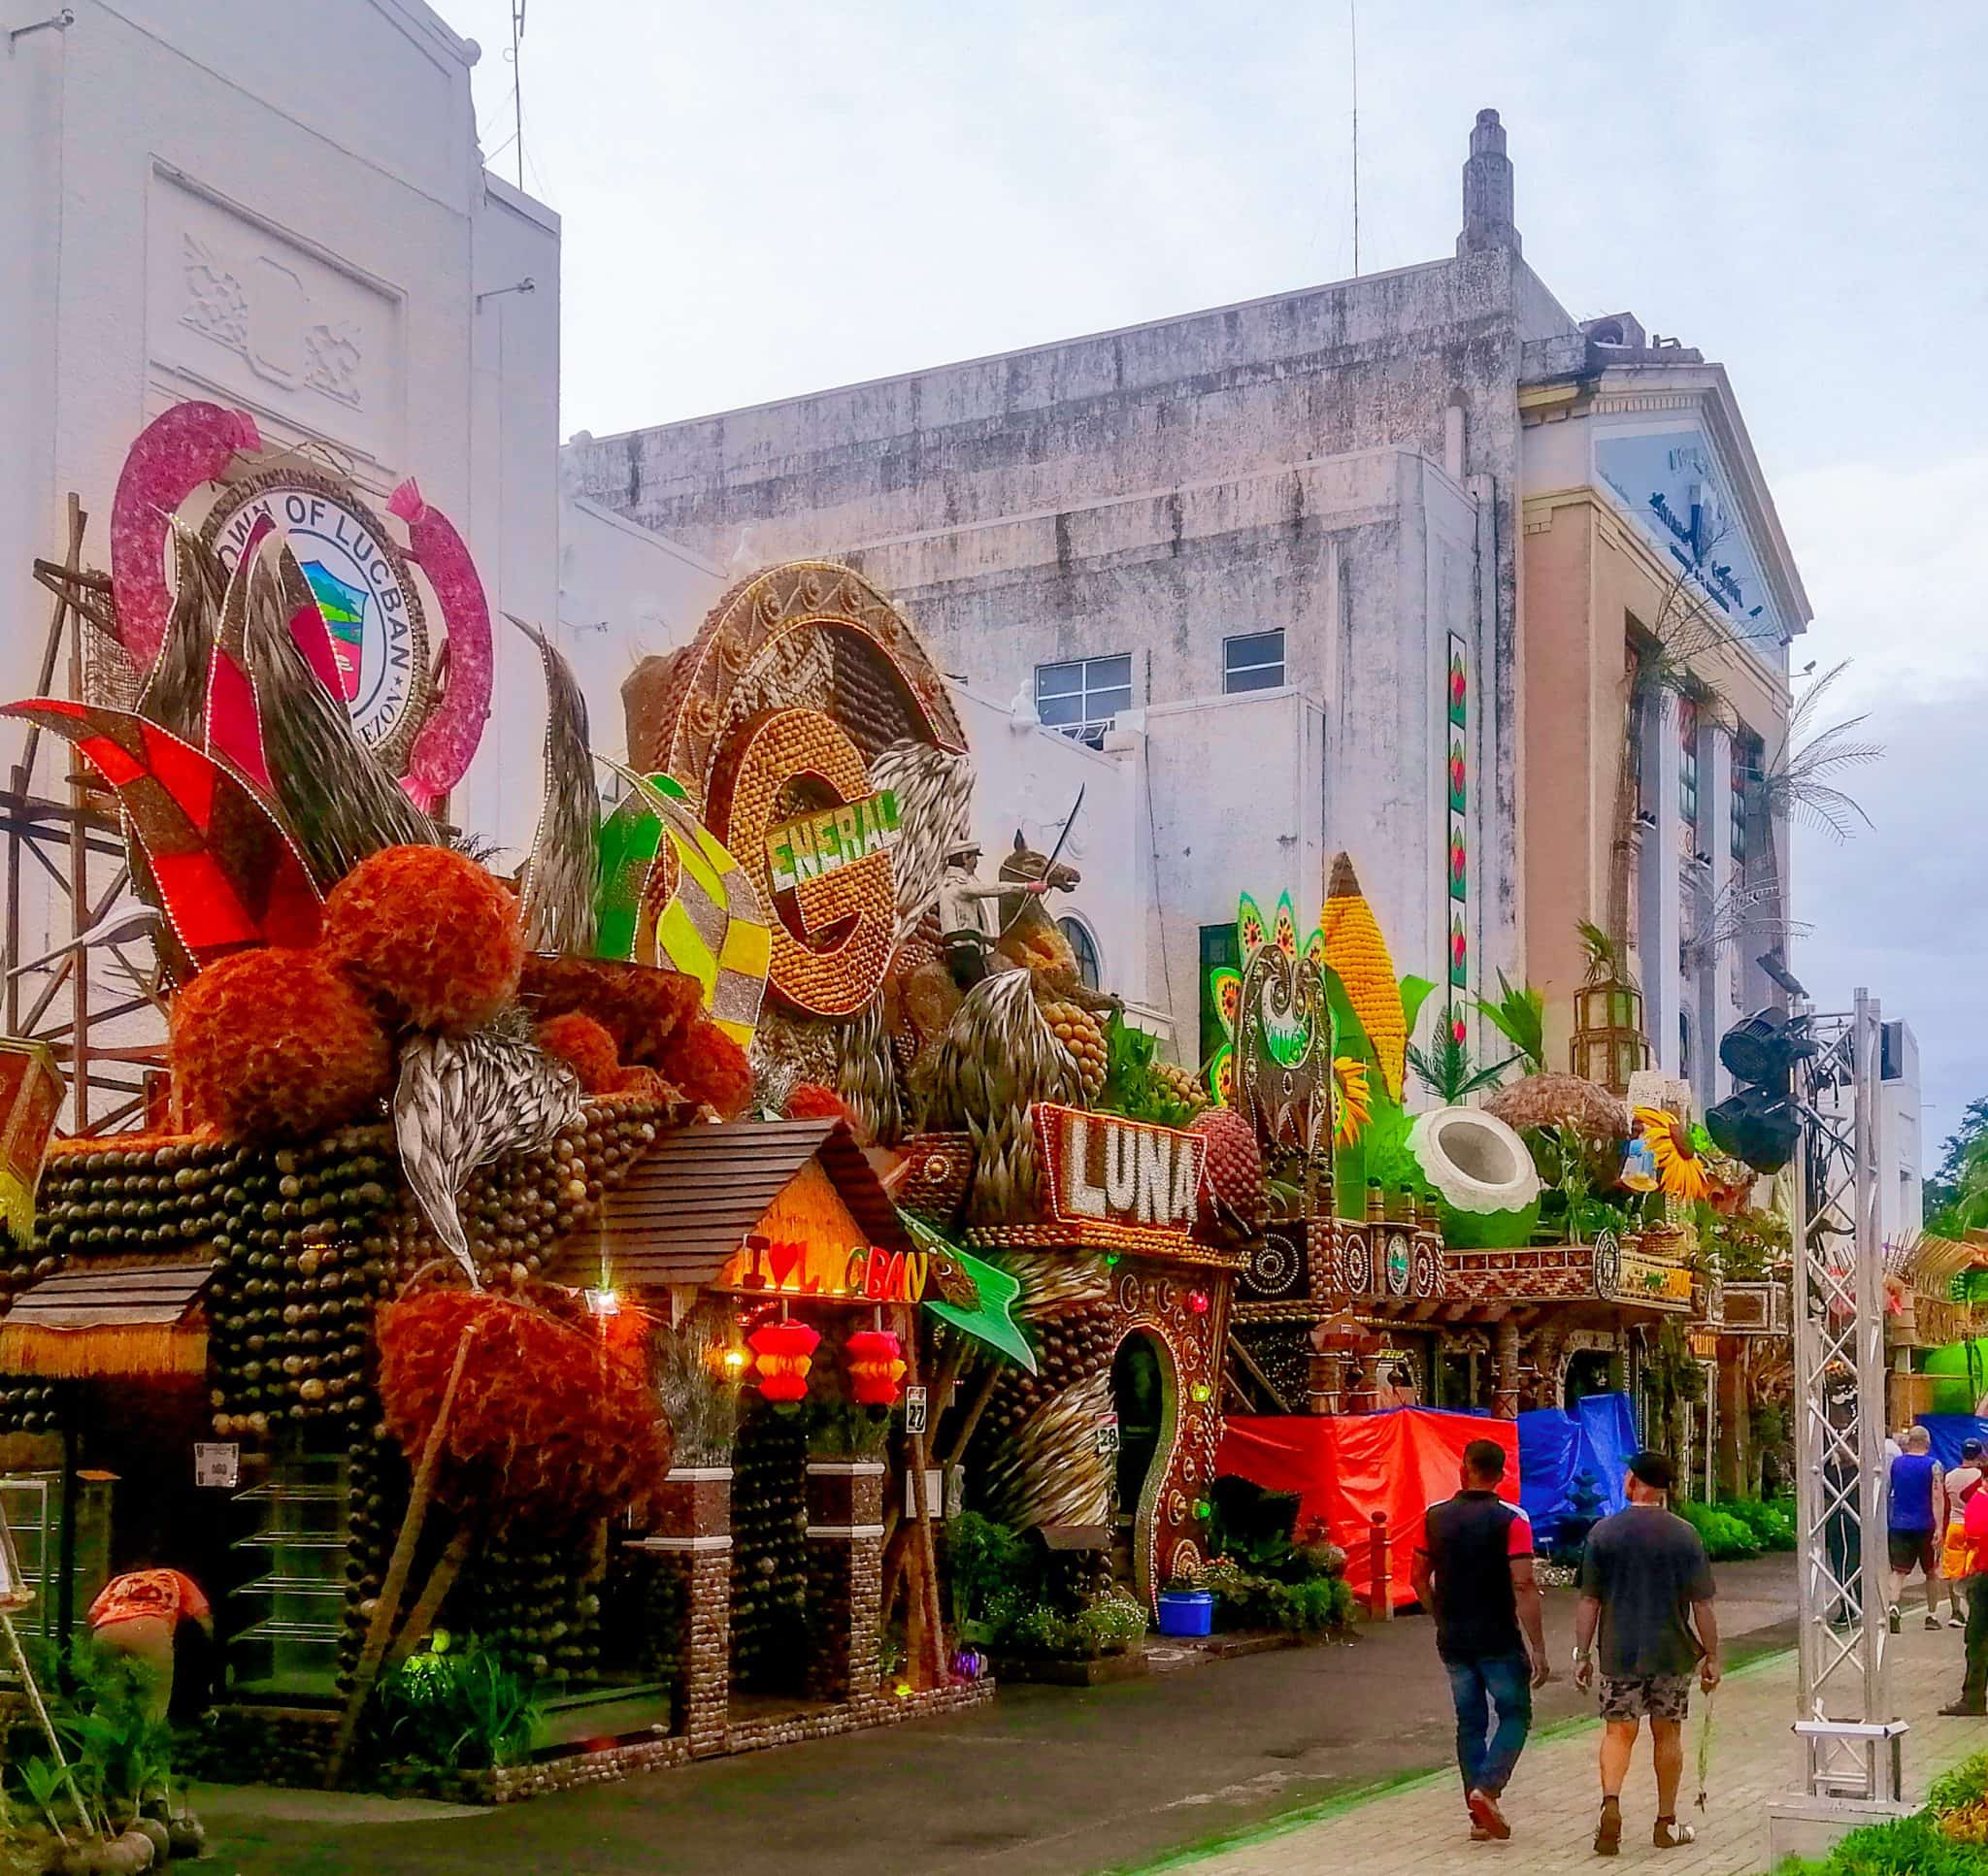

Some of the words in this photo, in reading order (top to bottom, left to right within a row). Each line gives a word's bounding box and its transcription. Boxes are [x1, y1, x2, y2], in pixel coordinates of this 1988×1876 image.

[217, 500, 274, 575] OWN
[286, 495, 326, 526] OF
[336, 515, 411, 670] LUCBAN
[356, 686, 404, 746] EZON
[1063, 1115, 1199, 1226] LUNA
[742, 1233, 771, 1291] I
[796, 1240, 928, 1302] LCBAN
[909, 1404, 925, 1428] 27
[1099, 1428, 1117, 1447] 28
